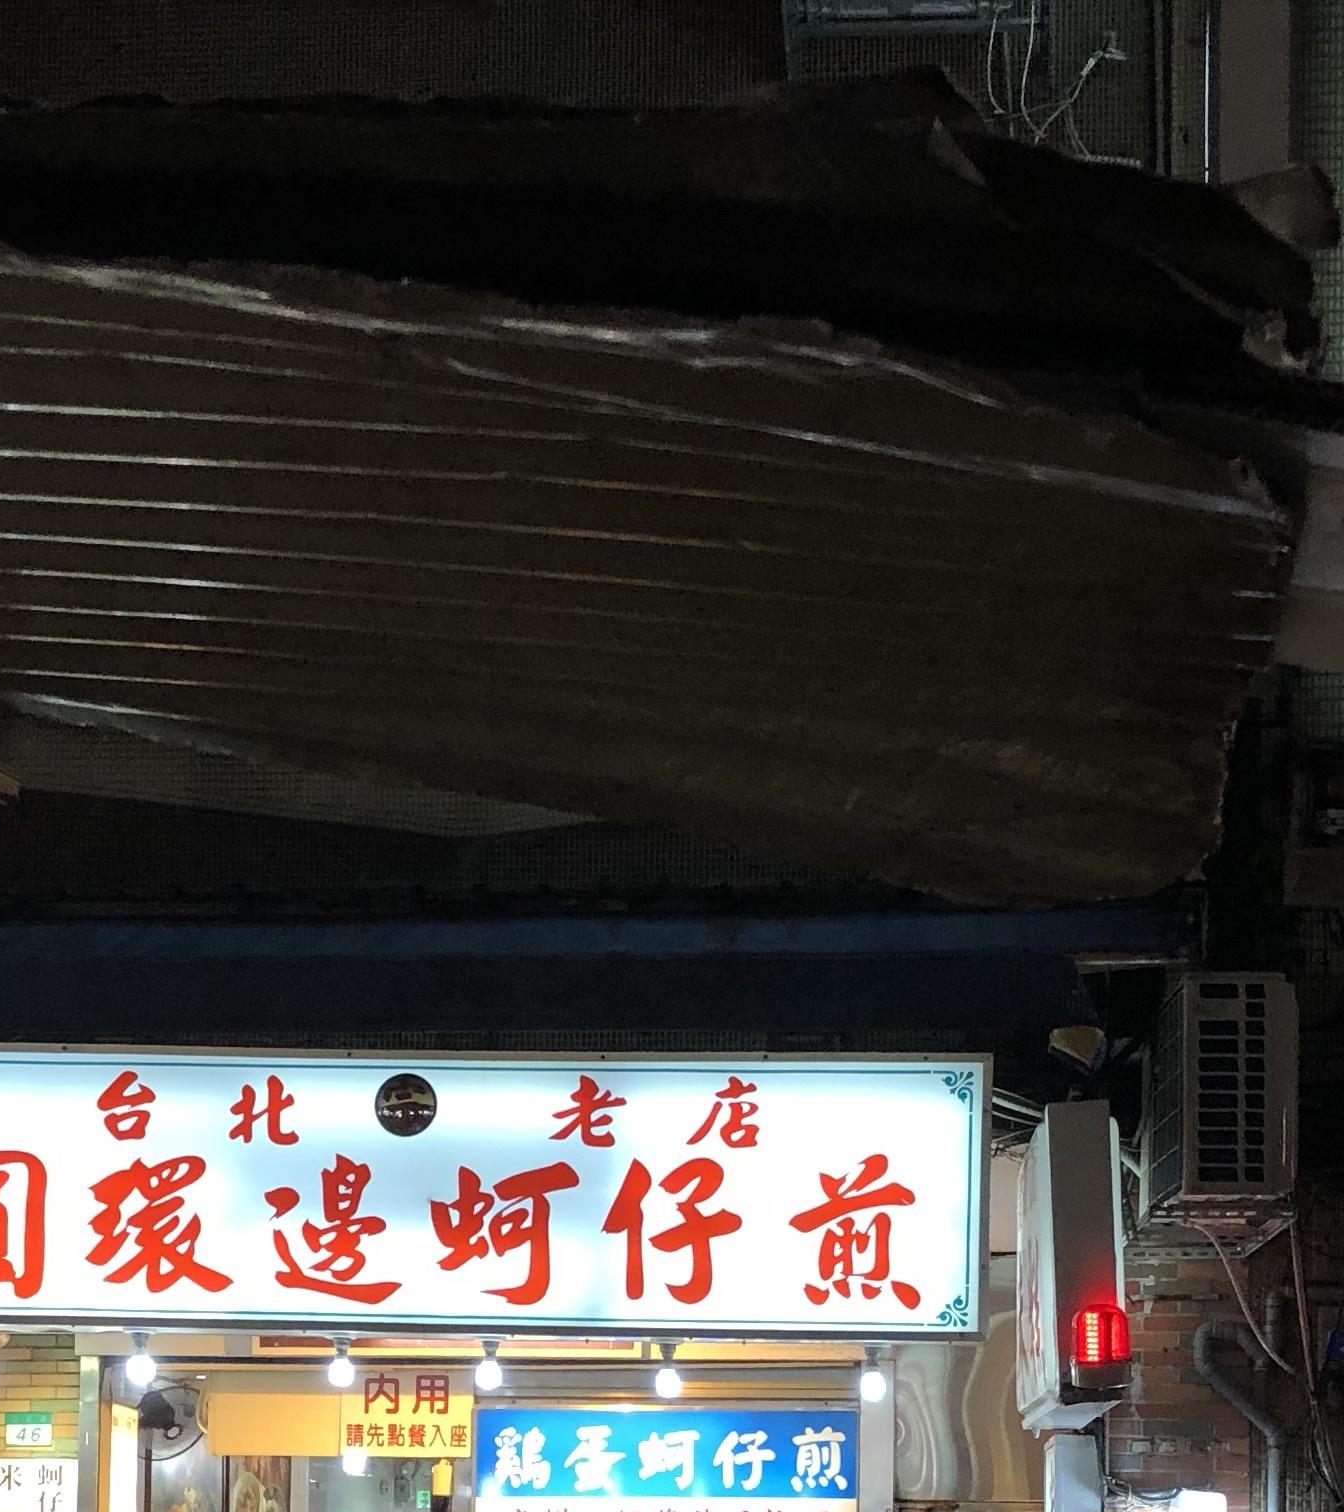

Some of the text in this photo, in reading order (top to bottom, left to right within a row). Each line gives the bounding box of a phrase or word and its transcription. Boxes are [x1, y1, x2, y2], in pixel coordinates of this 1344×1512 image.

[97, 1072, 759, 1149] 台北 老店
[15, 1427, 41, 1443] 46
[346, 1423, 468, 1448] 請先點餐入座
